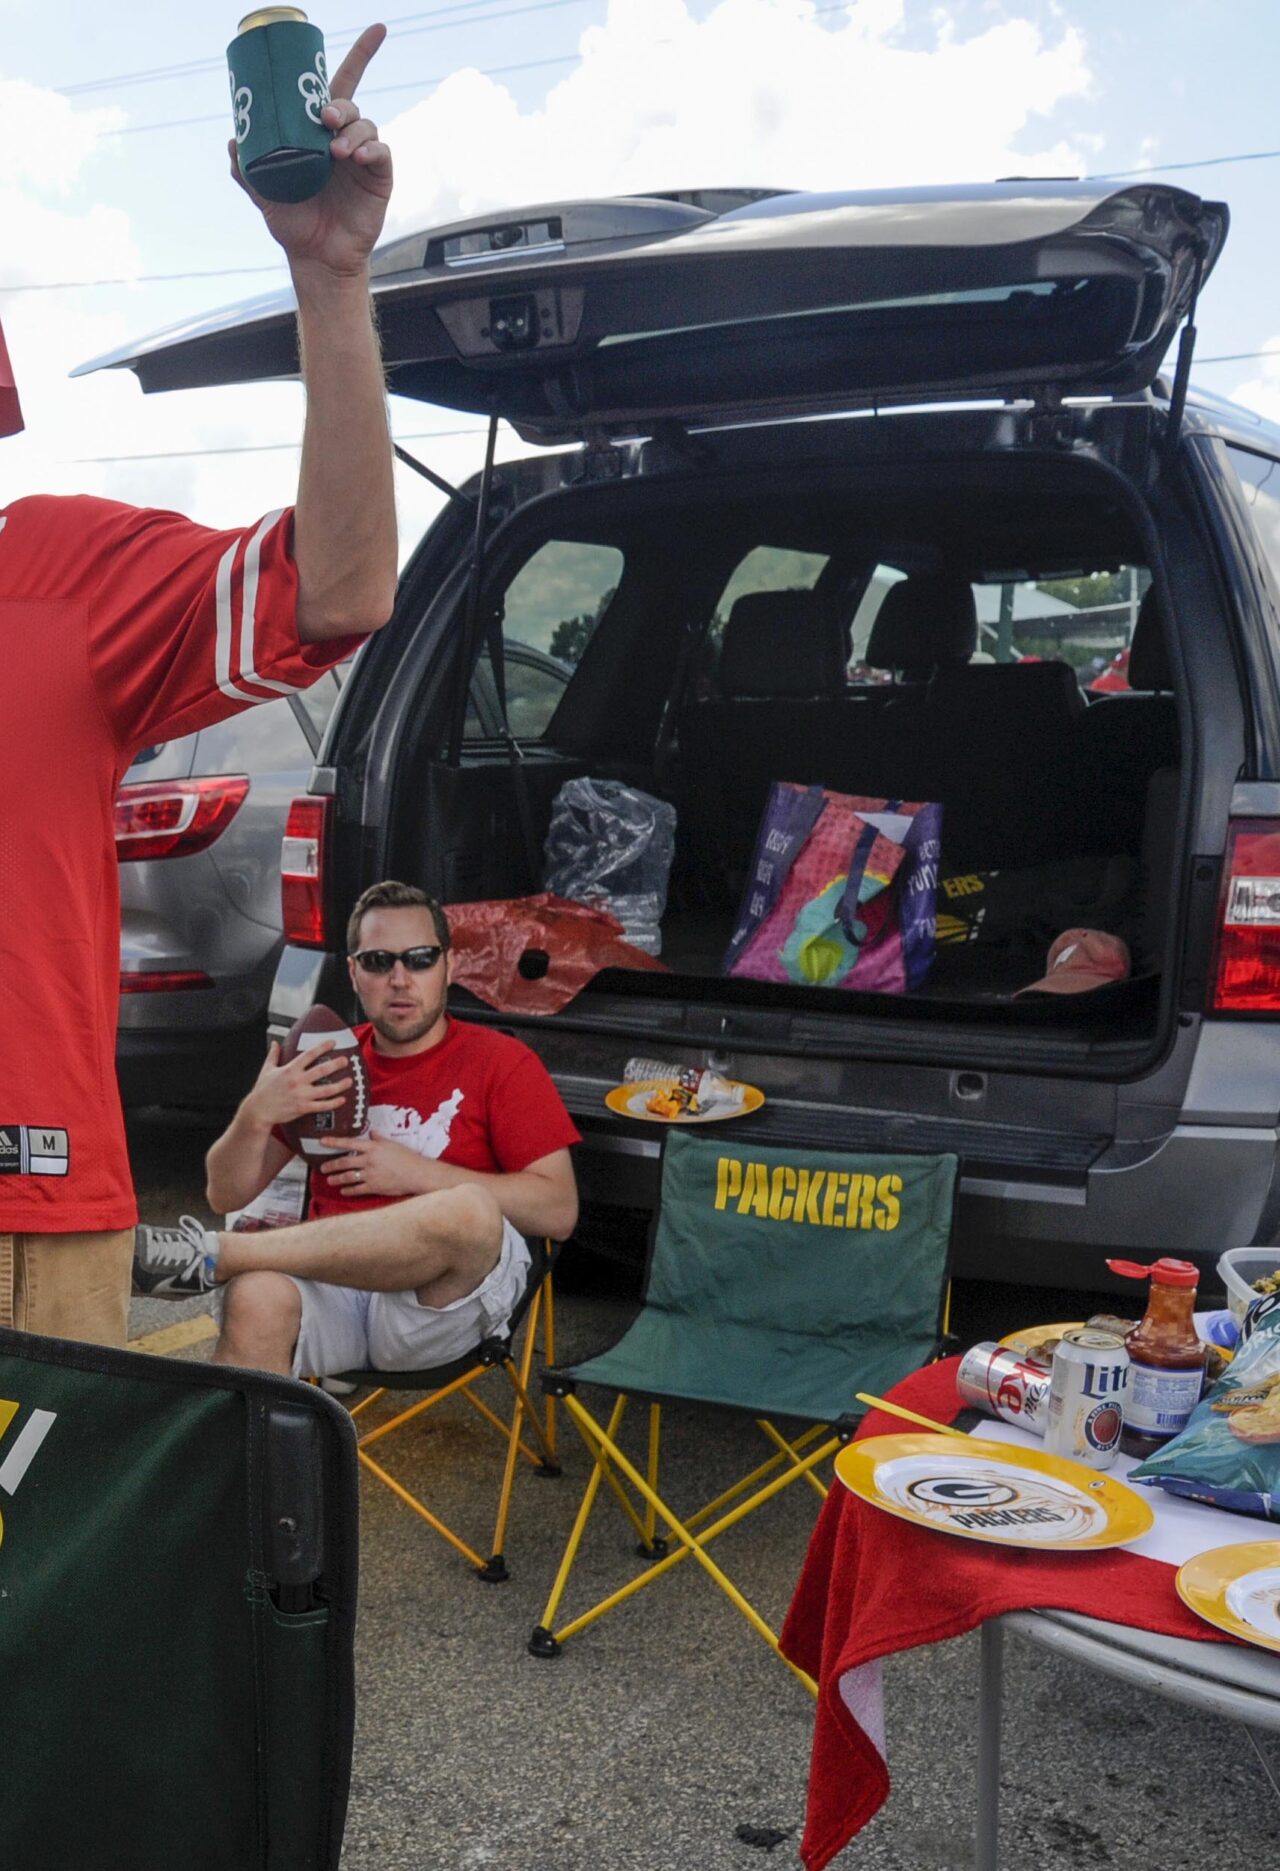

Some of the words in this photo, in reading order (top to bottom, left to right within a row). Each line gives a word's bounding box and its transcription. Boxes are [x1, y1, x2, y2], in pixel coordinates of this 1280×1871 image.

[942, 874, 985, 898] ERS
[42, 1135, 56, 1150] M
[715, 1157, 904, 1231] PACKERS
[949, 1507, 1066, 1529] PACKERS
